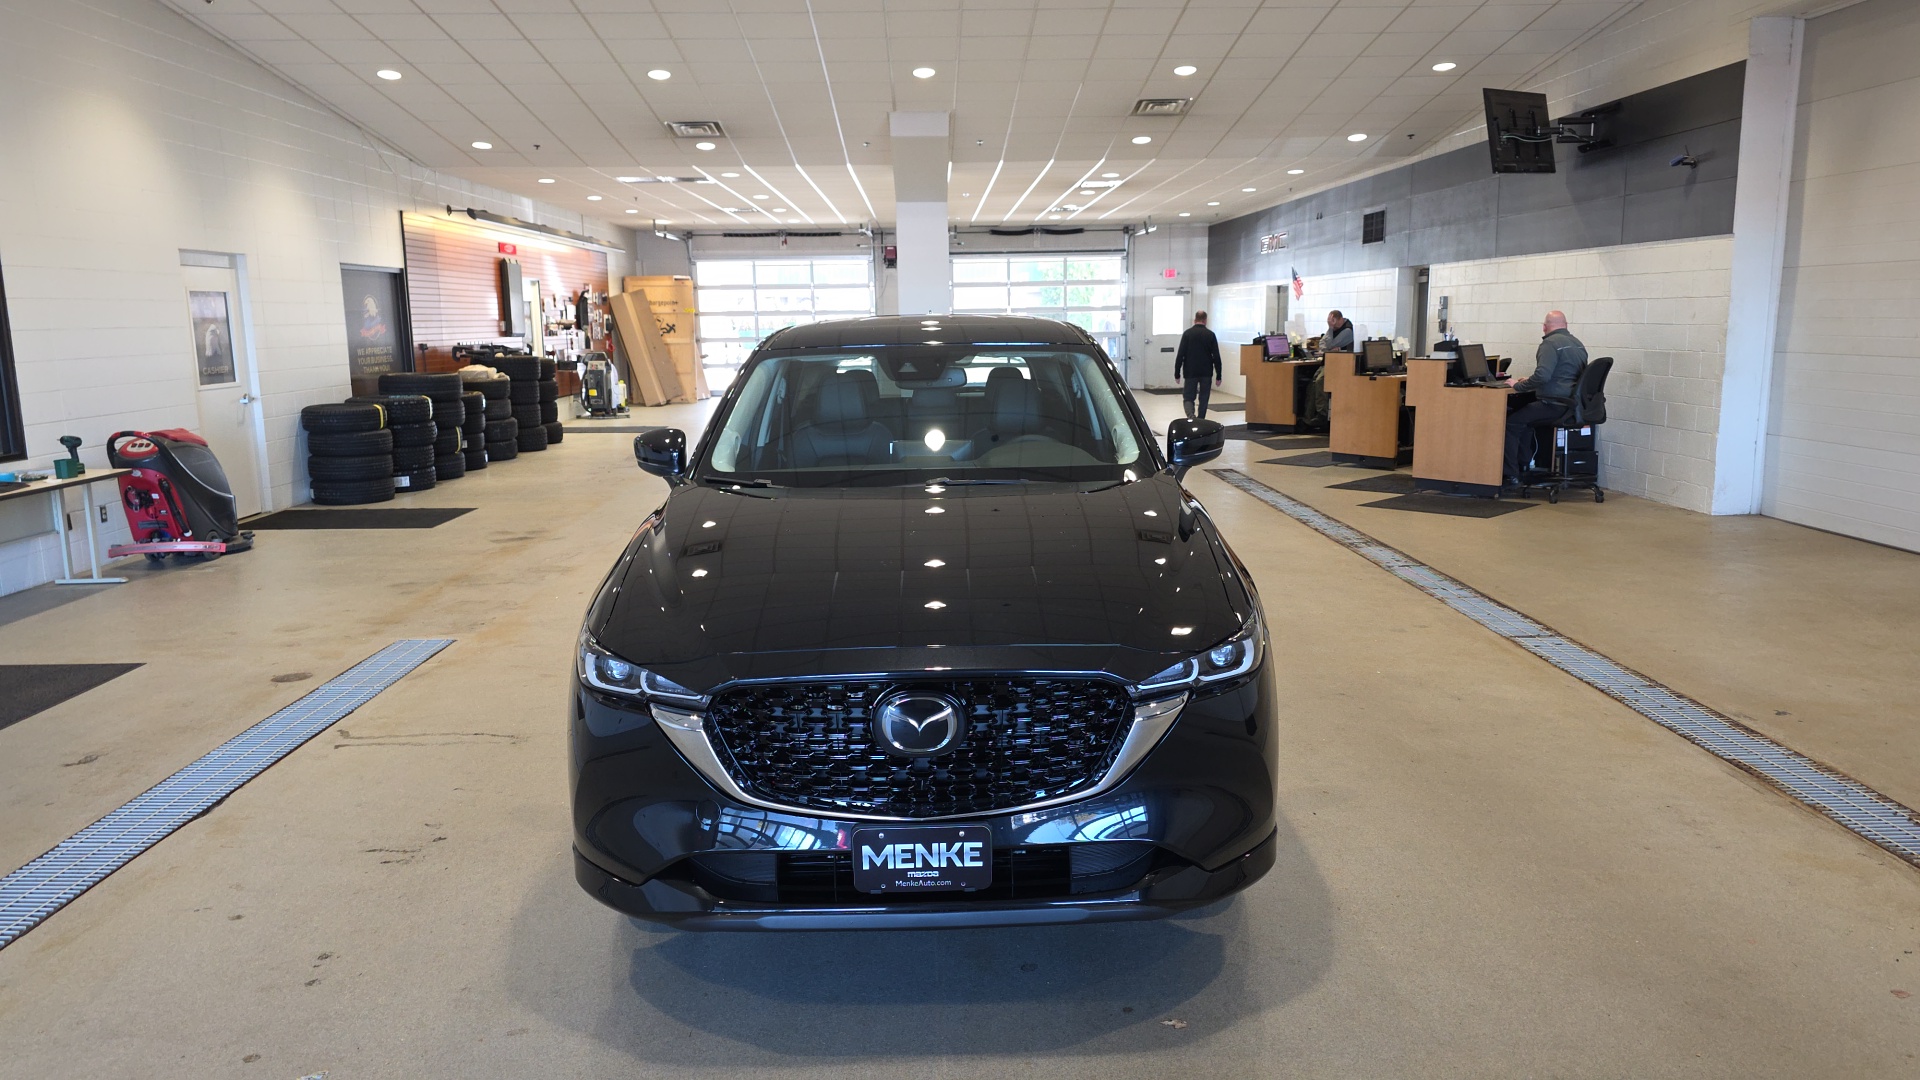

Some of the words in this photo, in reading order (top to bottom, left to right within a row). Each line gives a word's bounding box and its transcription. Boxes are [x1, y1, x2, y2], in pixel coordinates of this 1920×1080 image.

[1261, 232, 1288, 254] GMC
[357, 348, 365, 356] WE
[365, 346, 393, 355] APPRECIATE
[358, 357, 371, 365] YOUR
[202, 366, 229, 376] CASHIER
[363, 365, 380, 374] THANK
[862, 842, 983, 870] MENKE
